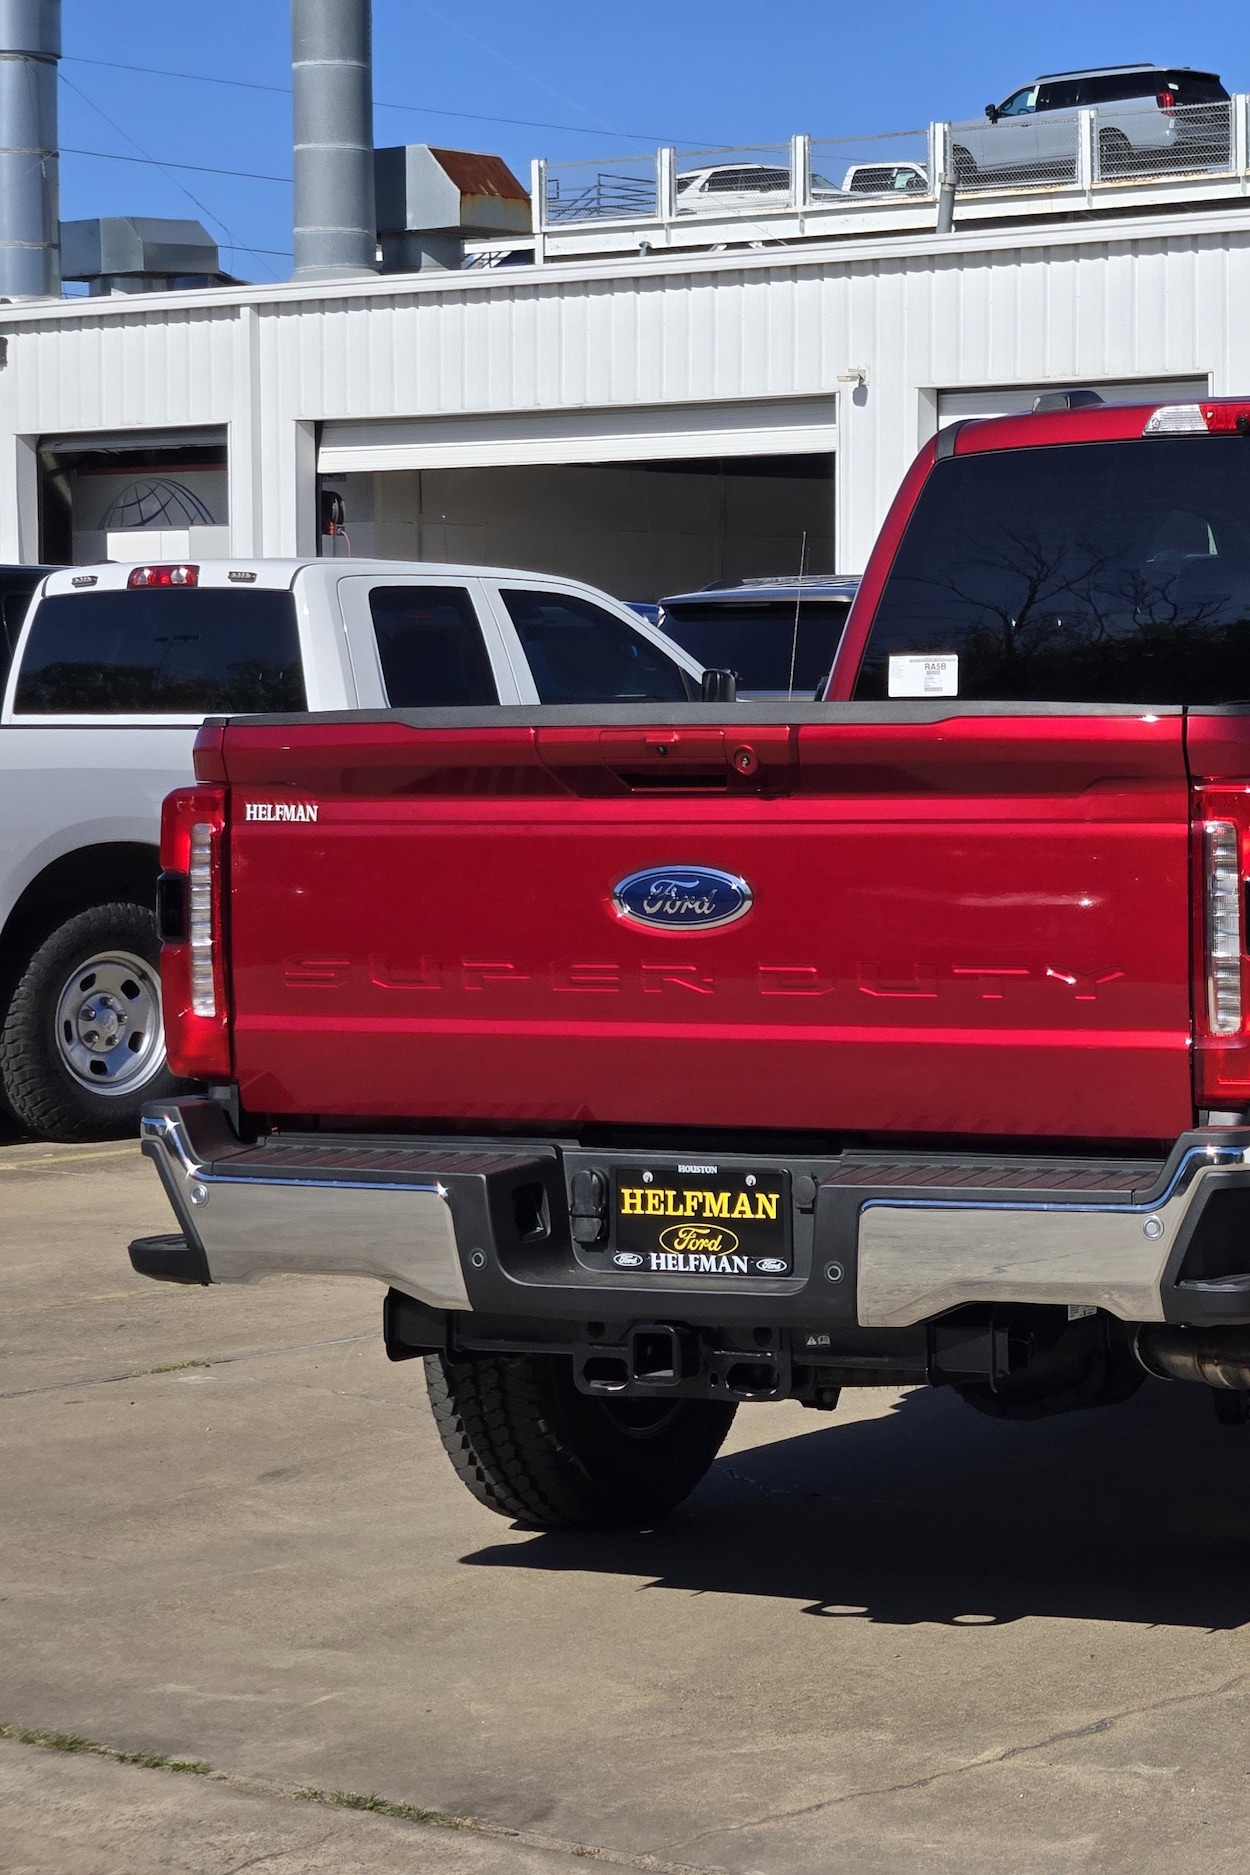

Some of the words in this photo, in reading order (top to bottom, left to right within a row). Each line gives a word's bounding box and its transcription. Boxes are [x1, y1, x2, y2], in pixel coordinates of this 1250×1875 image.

[924, 663, 947, 671] RA5B
[245, 803, 319, 822] HELFMAN
[643, 879, 719, 915] Ford
[283, 955, 715, 994] SUPER
[758, 961, 1126, 1000] DUTY
[678, 1164, 718, 1174] HOUSTON
[621, 1188, 780, 1220] HELFMAN
[673, 1227, 724, 1252] Ford
[650, 1252, 749, 1274] HELFMAN
